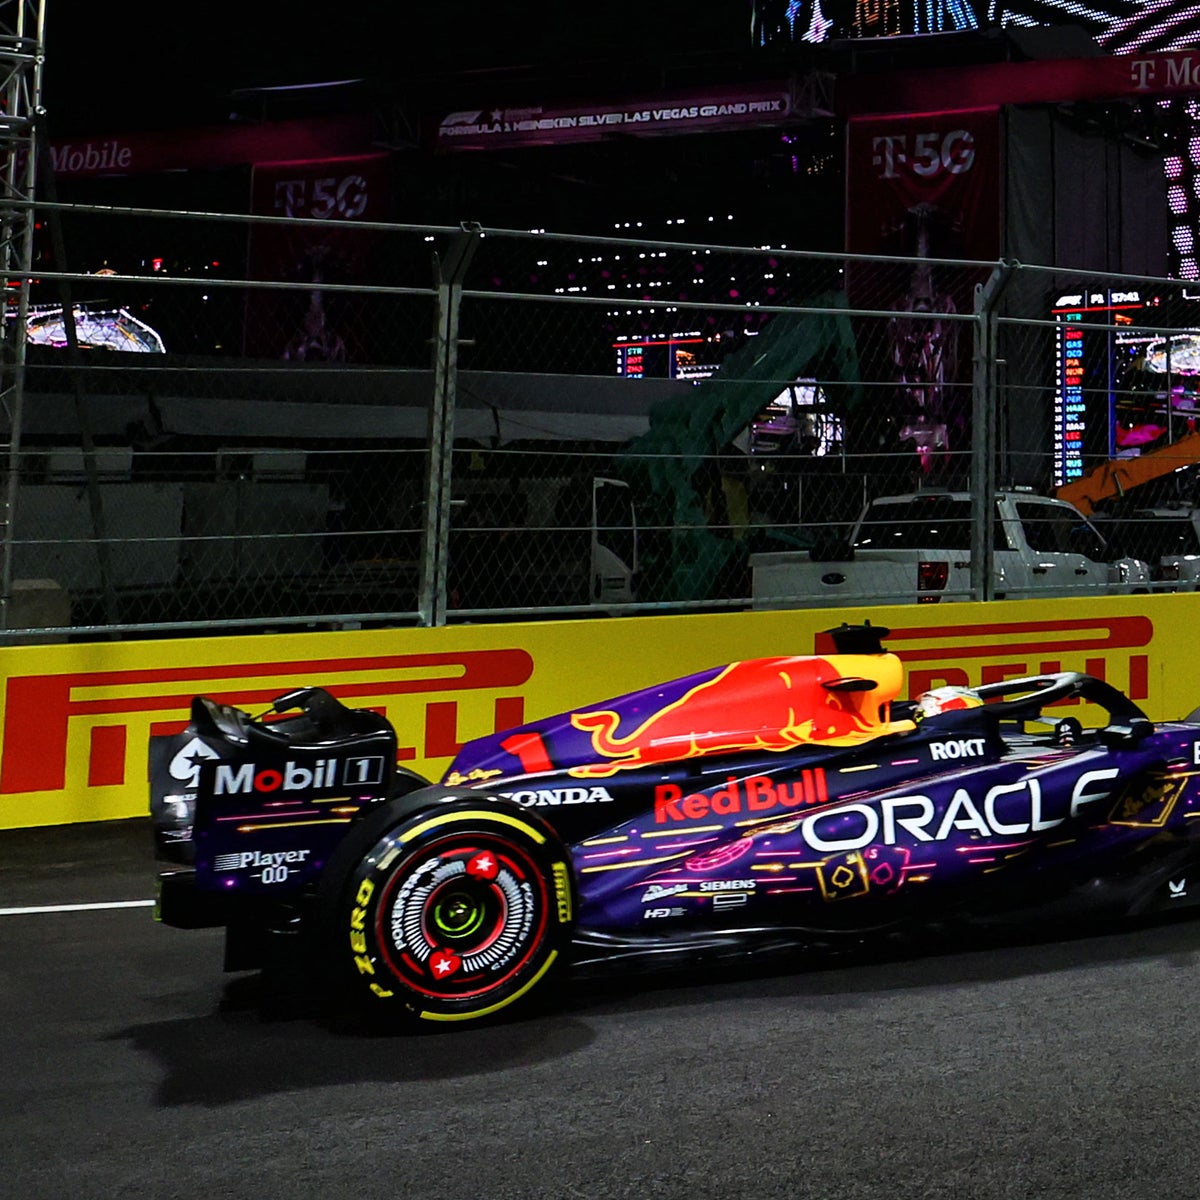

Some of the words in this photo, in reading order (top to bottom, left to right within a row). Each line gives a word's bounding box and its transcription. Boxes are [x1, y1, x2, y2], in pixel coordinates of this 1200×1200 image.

[438, 123, 502, 137] FORMULA
[578, 113, 622, 127] SILVER
[623, 111, 651, 123] LAS
[652, 107, 699, 121] VEGAS
[700, 103, 747, 116] GRAND
[749, 100, 781, 113] PRIX
[913, 129, 976, 177] 5G
[310, 175, 368, 220] 5G
[500, 732, 554, 775] 1
[929, 739, 986, 760] ROKT
[213, 759, 337, 795] Mobil
[499, 787, 614, 807] ONDA
[654, 776, 741, 824] Red
[744, 767, 829, 811] Bull
[801, 768, 1121, 852] ORACLE
[239, 849, 311, 869] Player
[700, 879, 757, 892] SIEMENS
[350, 878, 375, 975] ZERO
